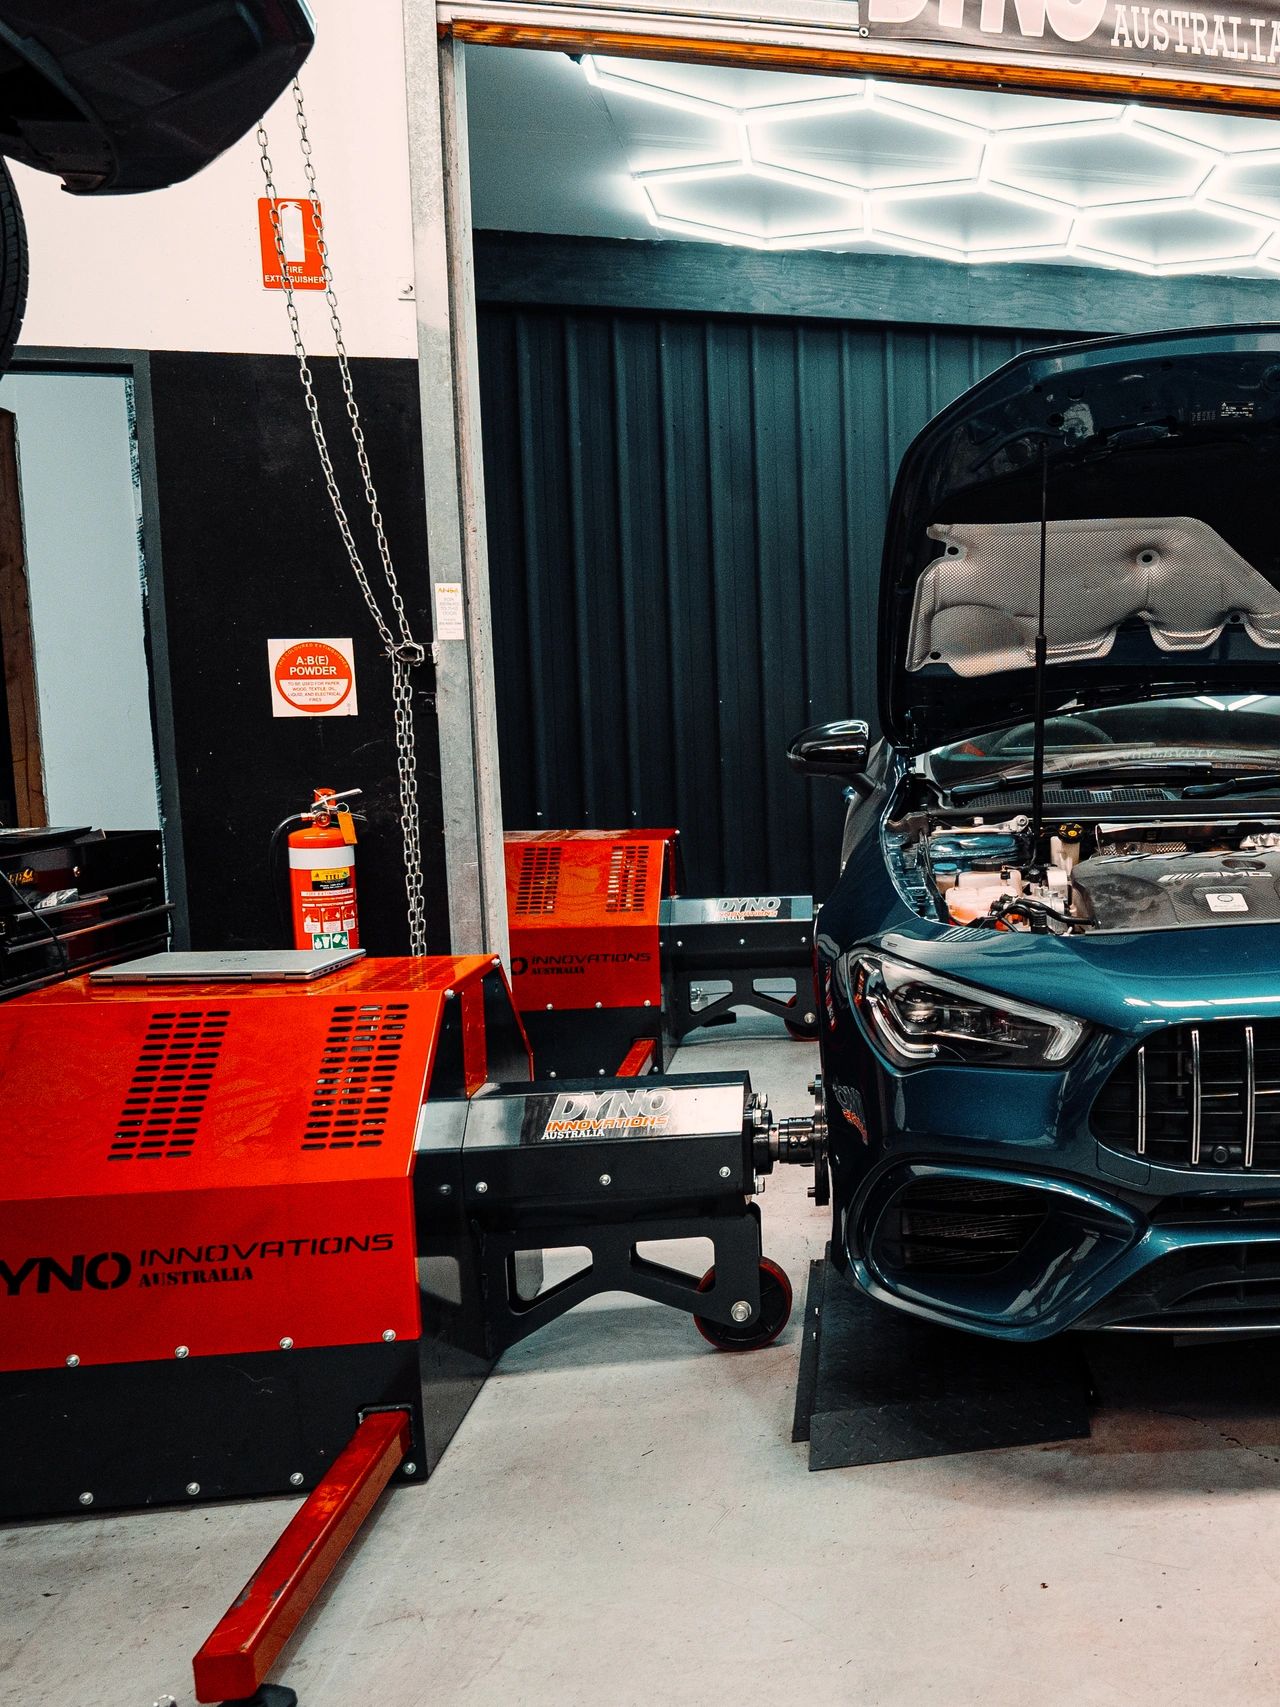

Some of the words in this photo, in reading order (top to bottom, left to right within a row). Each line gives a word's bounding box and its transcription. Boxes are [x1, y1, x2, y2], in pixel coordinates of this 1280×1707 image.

[286, 265, 303, 274] FIRE
[296, 655, 329, 666] A:B(E)
[289, 666, 337, 676] POWDER
[718, 897, 781, 911] DYNO
[531, 952, 652, 965] INNOVATIONS
[549, 1087, 675, 1121] DYNO
[546, 1115, 669, 1132] INNOVATIONS
[541, 1129, 605, 1140] AUSTRALIA
[0, 1252, 132, 1296] YNO
[139, 1233, 394, 1267] INNOVATIONS
[138, 1265, 254, 1289] AUSTRALIA
